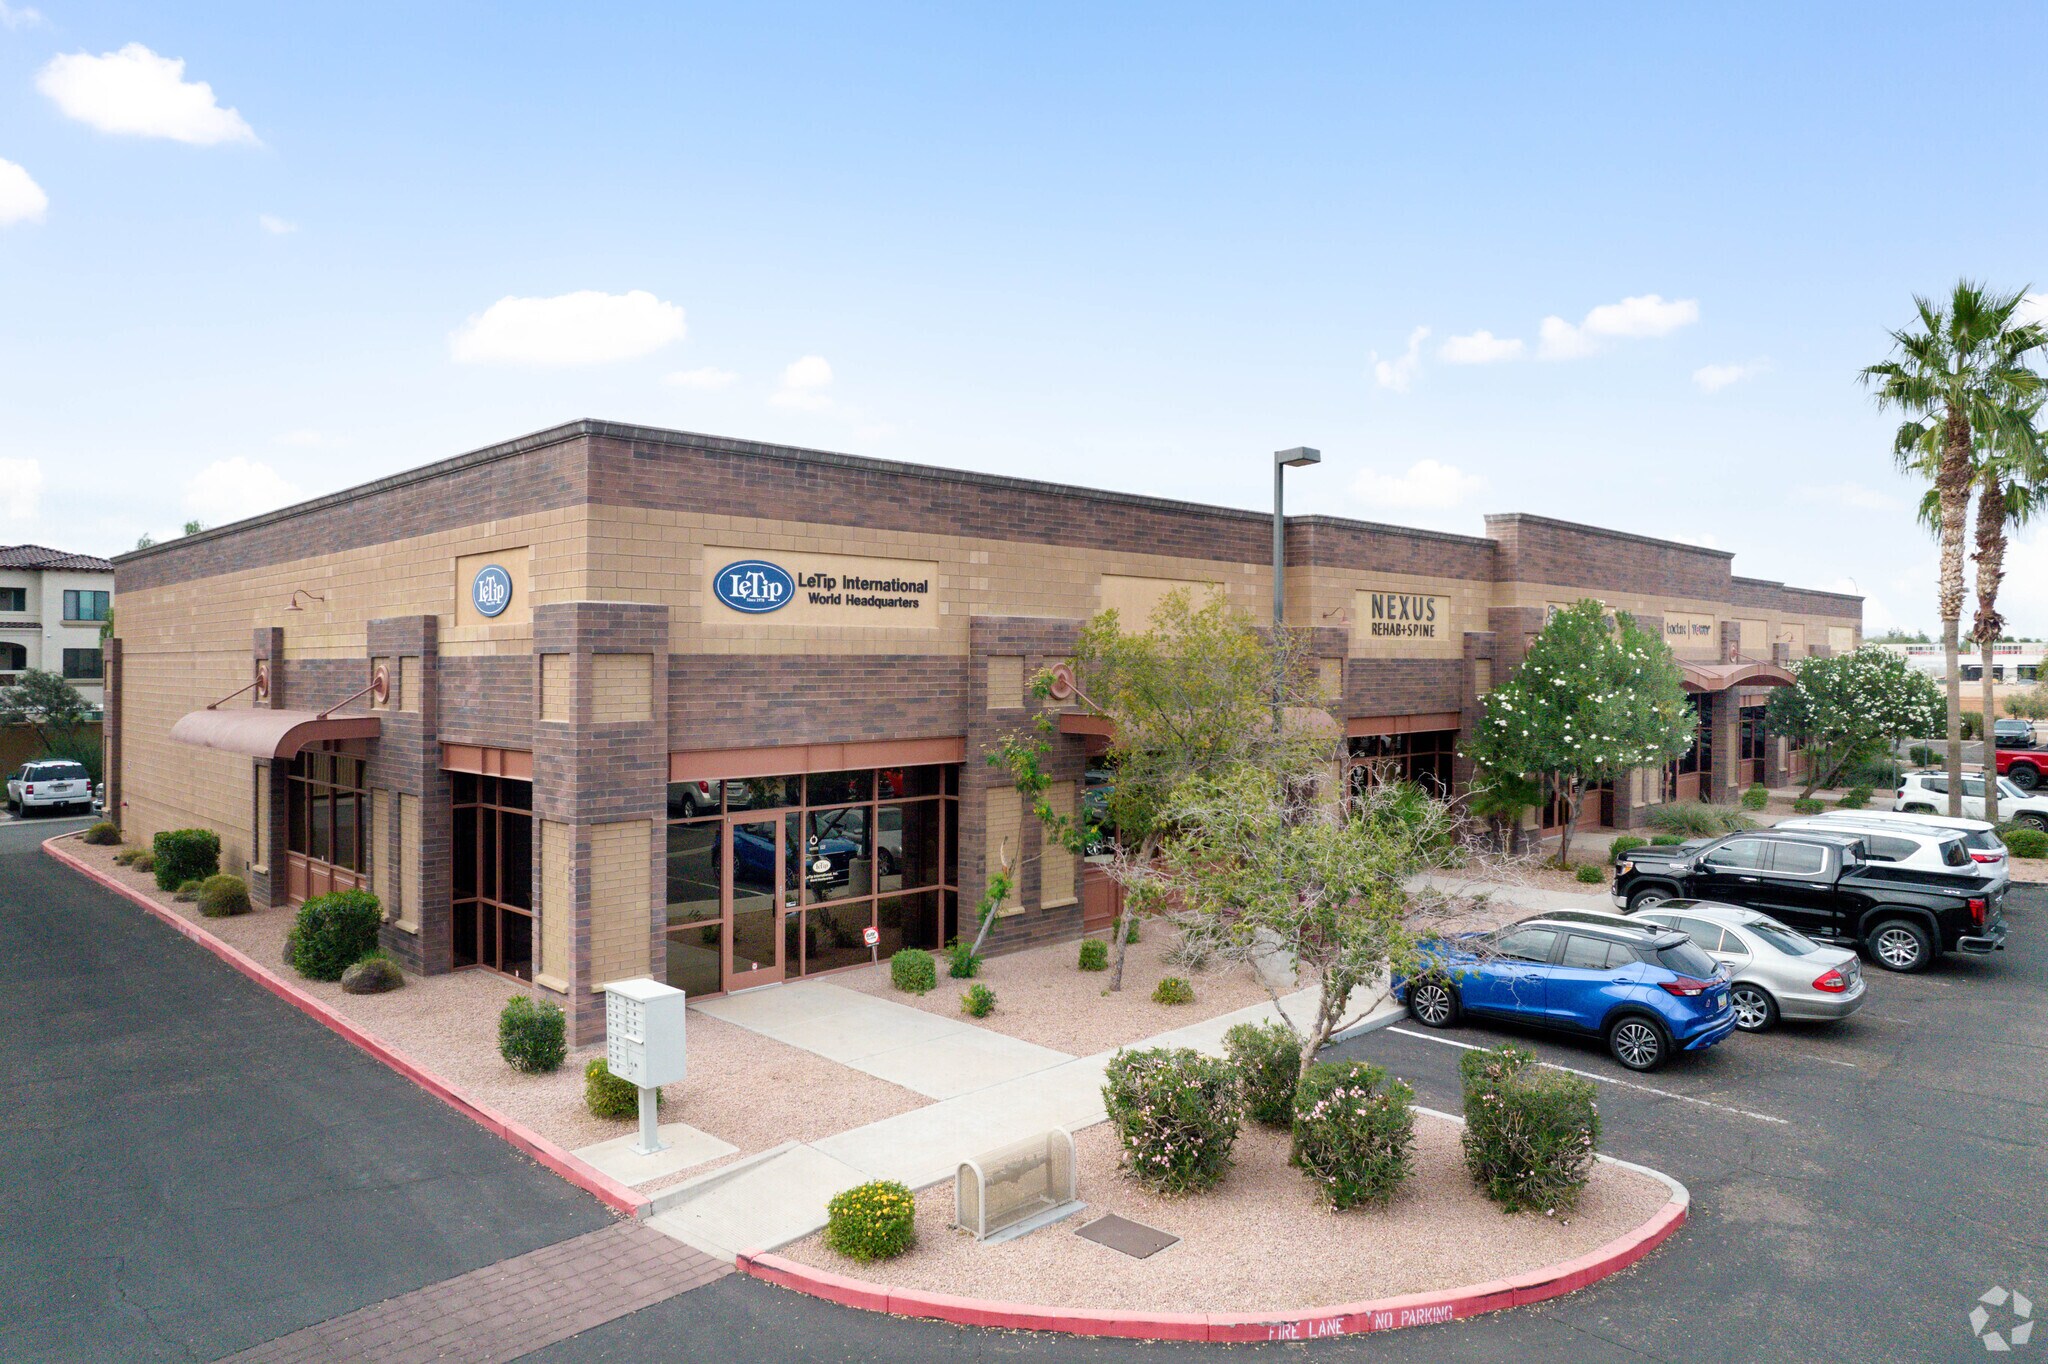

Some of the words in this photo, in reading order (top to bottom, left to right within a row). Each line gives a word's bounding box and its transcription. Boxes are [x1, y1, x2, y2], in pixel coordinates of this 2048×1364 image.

[478, 575, 505, 604] LeTip
[729, 570, 783, 602] LeTip
[798, 572, 837, 591] LeTip
[842, 575, 928, 593] International
[808, 592, 842, 605] World
[846, 594, 919, 609] Headquarters
[1371, 593, 1436, 622] NEXUS
[1371, 622, 1435, 638] REHAB+SPINE
[1268, 1322, 1300, 1341] FIRE
[1309, 1317, 1345, 1338] LANE
[1375, 1312, 1393, 1330] NO
[1401, 1304, 1453, 1327] PARKING
